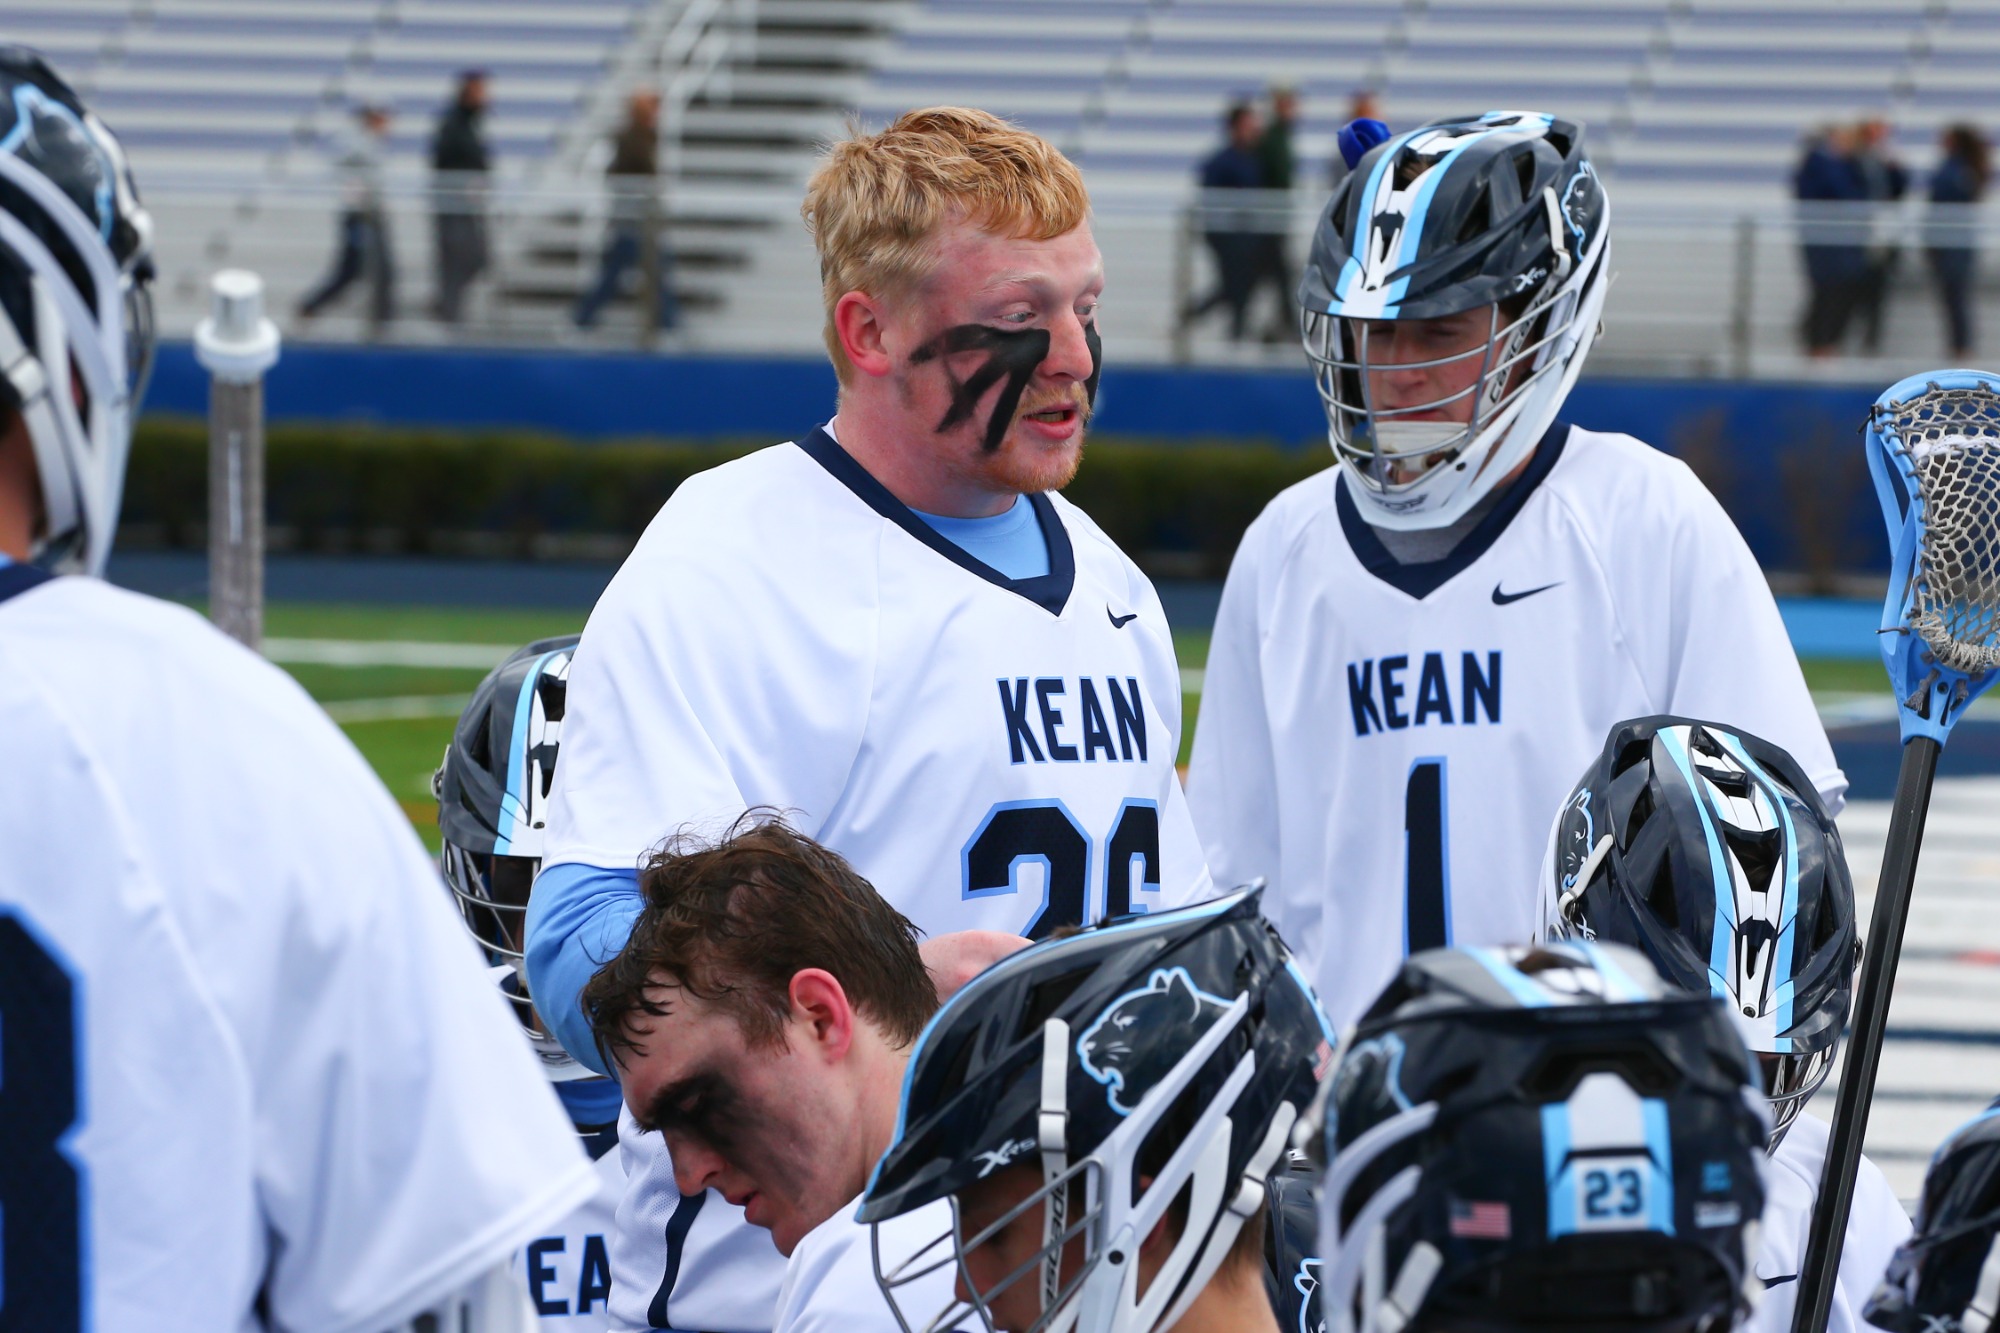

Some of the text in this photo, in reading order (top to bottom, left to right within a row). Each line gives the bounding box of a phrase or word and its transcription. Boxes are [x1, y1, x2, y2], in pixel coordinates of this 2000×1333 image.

[996, 675, 1150, 766] KEAN
[1346, 650, 1502, 738] KEAN
[1402, 755, 1455, 958] 1
[1584, 1169, 1643, 1218] 23
[526, 1234, 612, 1317] EA
